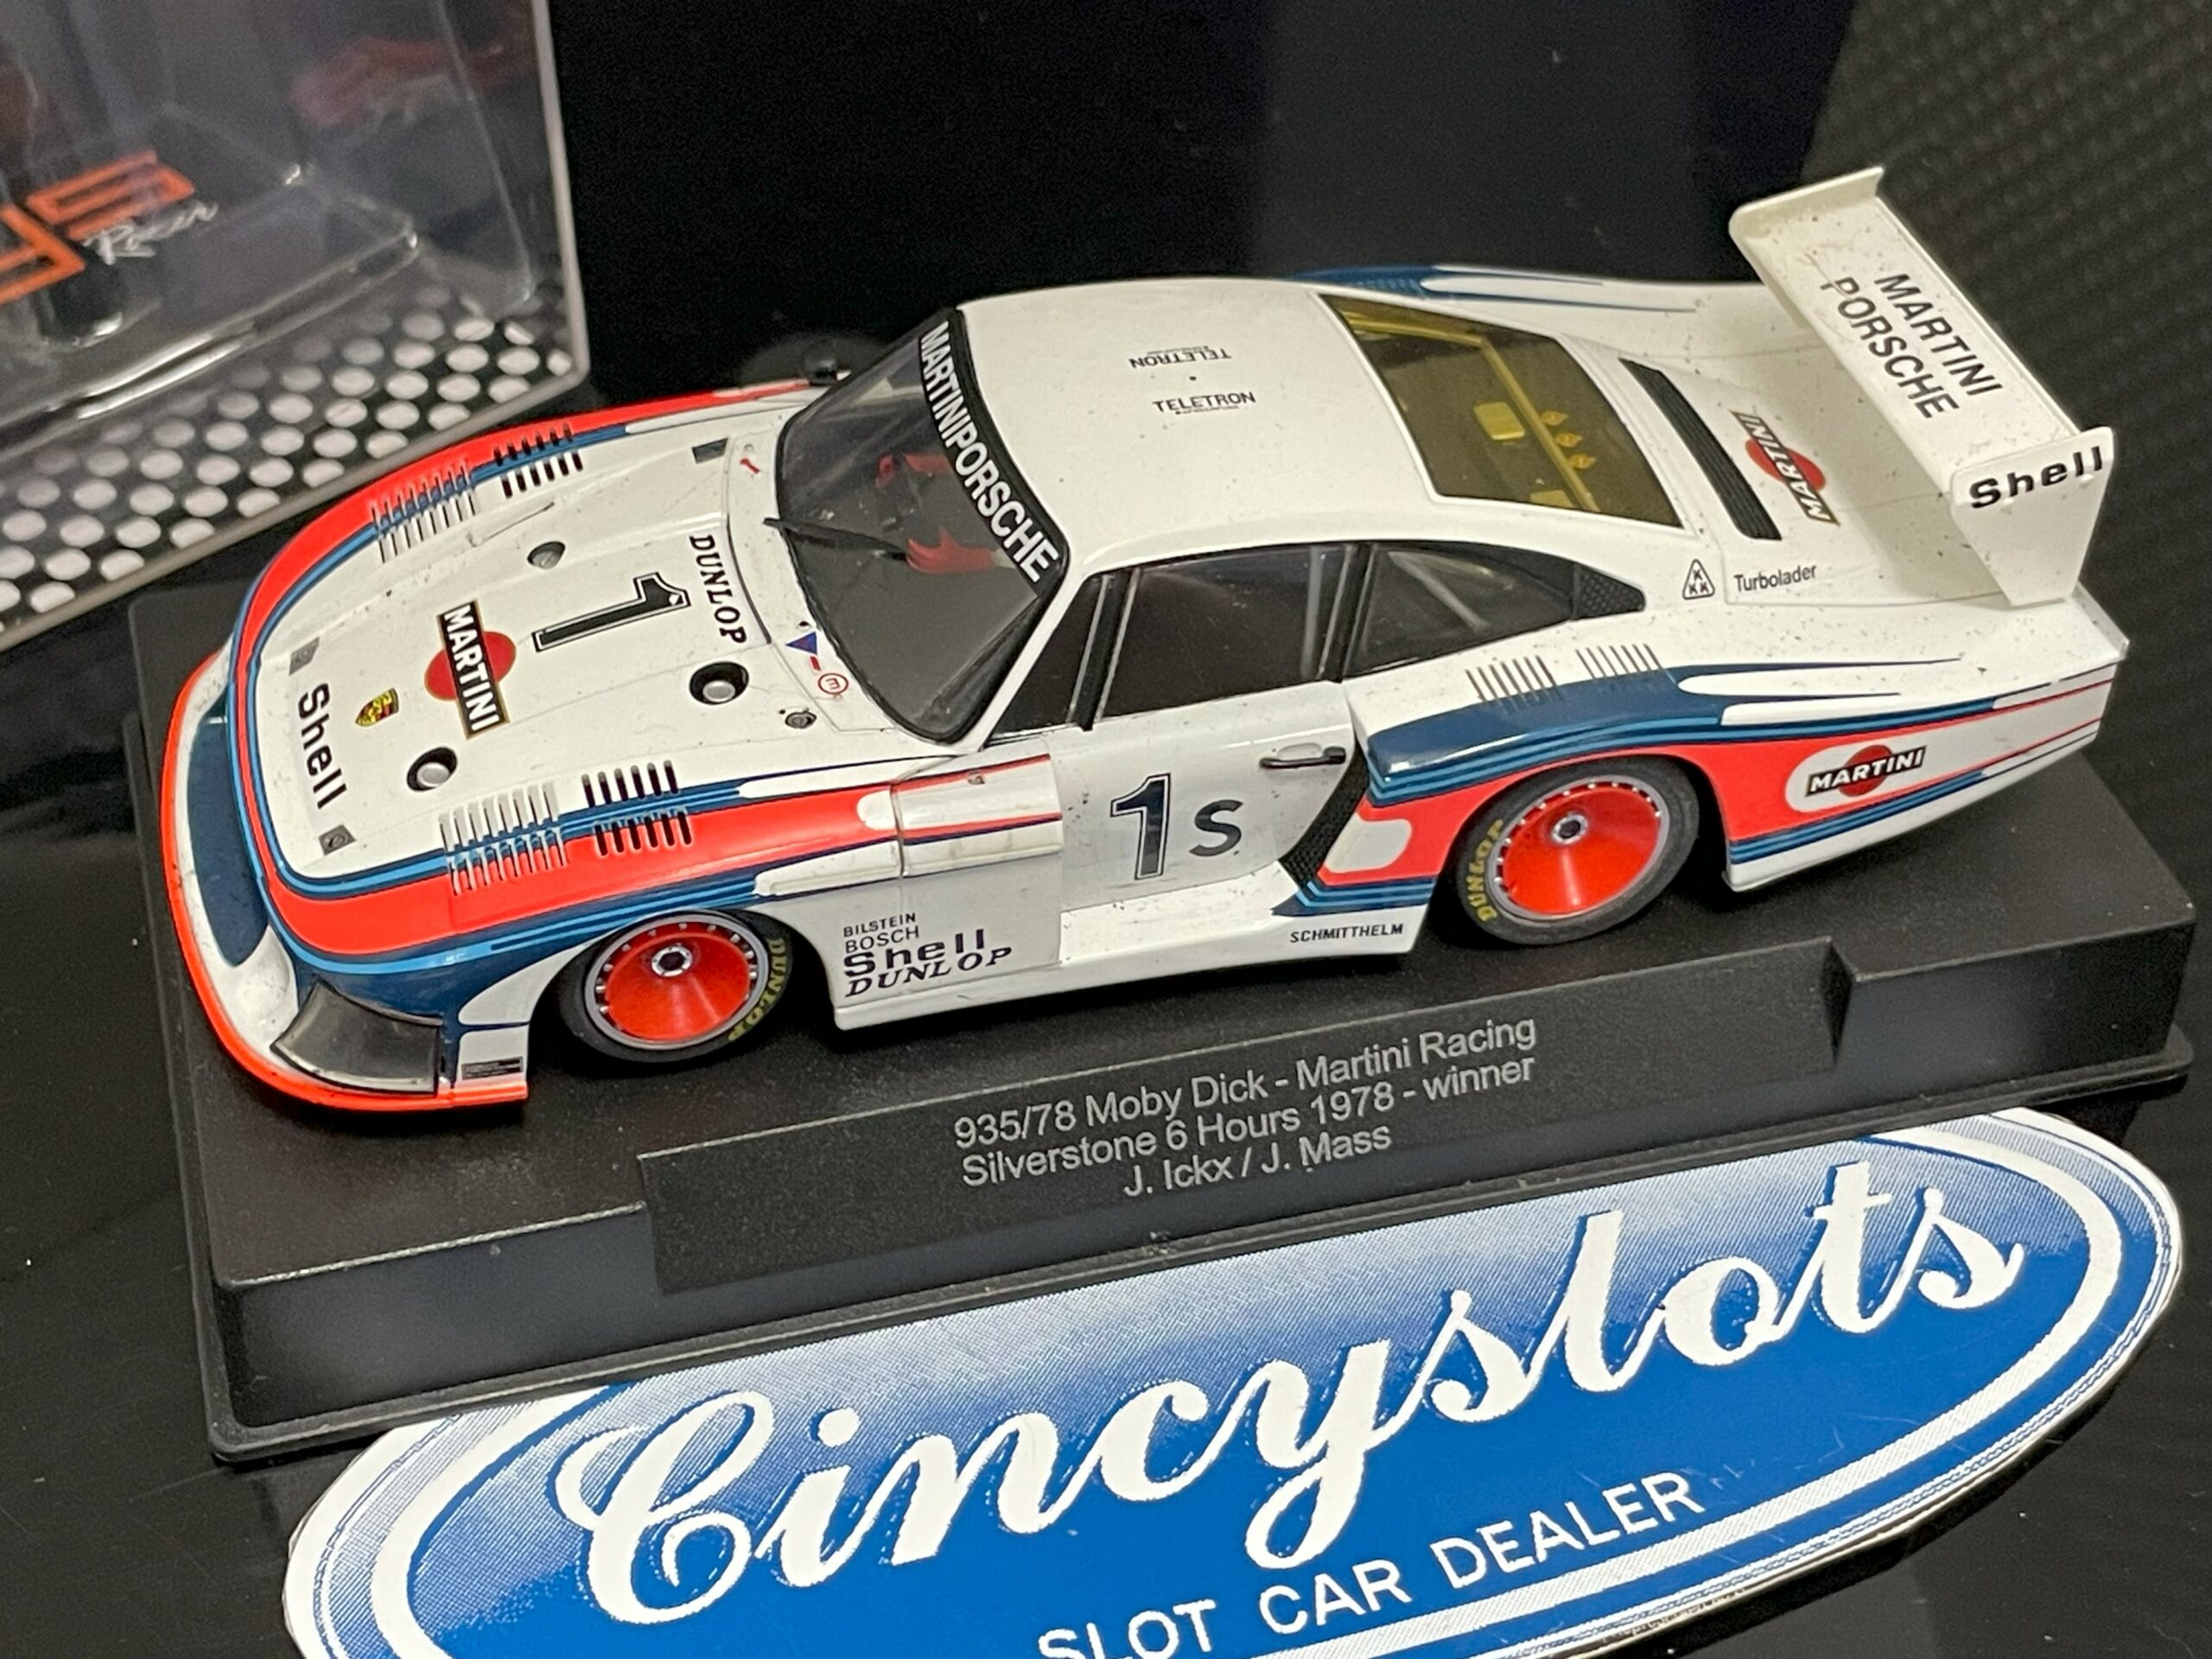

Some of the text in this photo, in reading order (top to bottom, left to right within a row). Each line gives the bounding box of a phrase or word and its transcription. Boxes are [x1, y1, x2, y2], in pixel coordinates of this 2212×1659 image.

[1128, 348, 1232, 368] TELETRON
[1820, 276, 1960, 419] PORSCHE
[1873, 273, 2003, 397] MARTINI
[1152, 391, 1256, 413] TELETRON
[1735, 412, 1834, 522] MARTINI
[1968, 445, 2103, 510] Shell
[531, 571, 692, 652] 1
[689, 534, 747, 645] DUNLOP
[1733, 565, 1817, 593] Turbolader
[443, 605, 501, 732] MARTINI
[297, 683, 347, 810] Shell
[1809, 748, 1925, 794] MARTINI
[1466, 819, 1503, 922] DUNLOP
[843, 912, 916, 938] BILSTEIN
[843, 928, 984, 977] Shell
[845, 925, 919, 953] BOSCH
[1289, 923, 1405, 944] SCHMITTHELM
[845, 947, 1012, 997] DUNLOP
[954, 1100, 1077, 1149] 935/78
[1085, 1085, 1182, 1127] Moby
[1191, 1069, 1268, 1109] Dick
[1296, 1038, 1411, 1090] Martini
[1419, 1019, 1536, 1064] Racing
[962, 1131, 1158, 1186] Silverstone
[1166, 1119, 1188, 1151] 6
[1197, 1107, 1300, 1147] Hours
[1311, 1081, 1395, 1125] 1978
[1422, 1057, 1535, 1101] winner
[1123, 1165, 1154, 1197] J.
[1164, 1154, 1234, 1191] Ickx
[1261, 1142, 1290, 1173] J.
[1299, 1125, 1392, 1166] Mass
[555, 1161, 2027, 1625] Cincyslots
[1038, 1471, 1706, 1659] SLOT CAR DEALER
